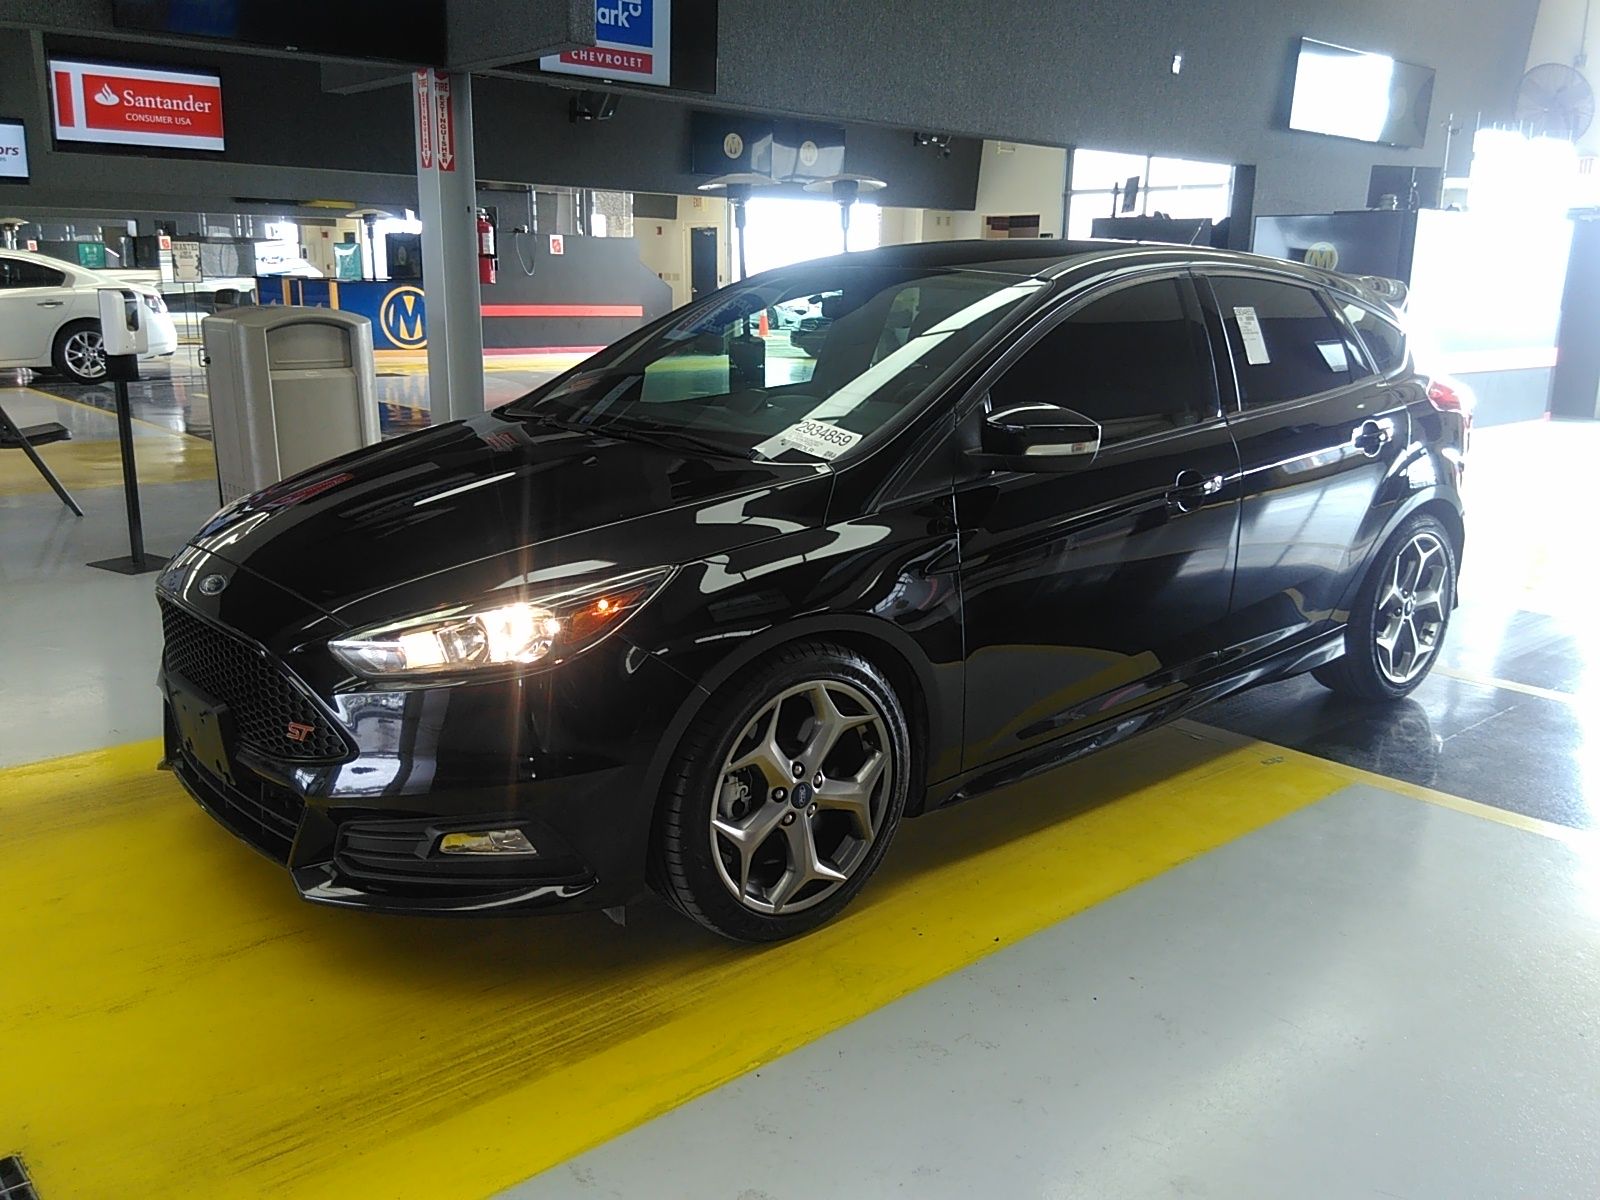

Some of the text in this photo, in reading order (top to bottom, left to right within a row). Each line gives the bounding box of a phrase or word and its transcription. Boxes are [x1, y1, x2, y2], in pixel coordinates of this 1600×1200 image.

[571, 50, 642, 68] CHEVROLET
[123, 89, 212, 113] Santander
[125, 112, 192, 126] CONSUMER USA
[434, 81, 450, 164] FIRE EXTINGUISHER
[795, 421, 853, 447] 2934859
[286, 721, 315, 741] ST
